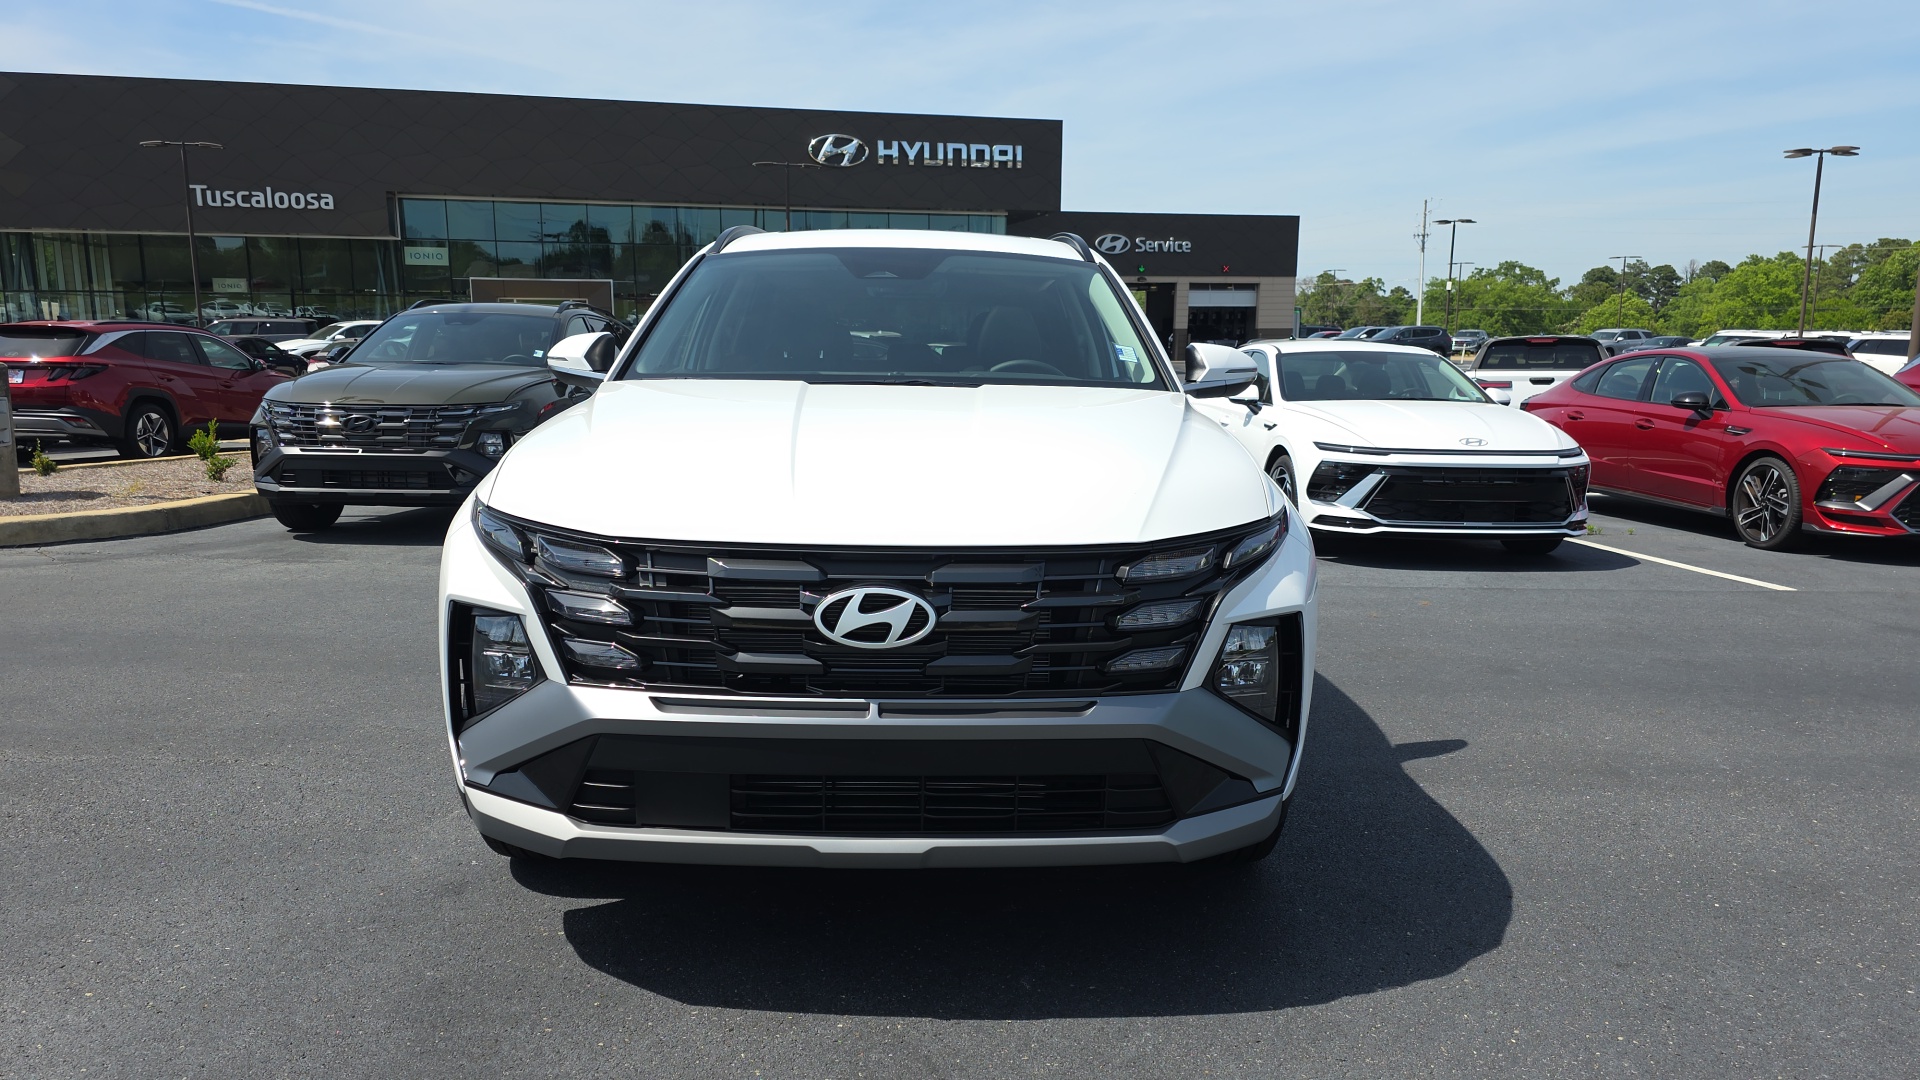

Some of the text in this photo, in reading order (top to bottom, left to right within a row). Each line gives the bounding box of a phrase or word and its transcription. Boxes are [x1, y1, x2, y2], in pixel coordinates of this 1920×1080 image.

[877, 139, 1023, 169] HYUNDAI
[189, 184, 335, 210] Tuscaloosa
[1135, 236, 1192, 253] Service
[409, 252, 443, 261] IONIQ
